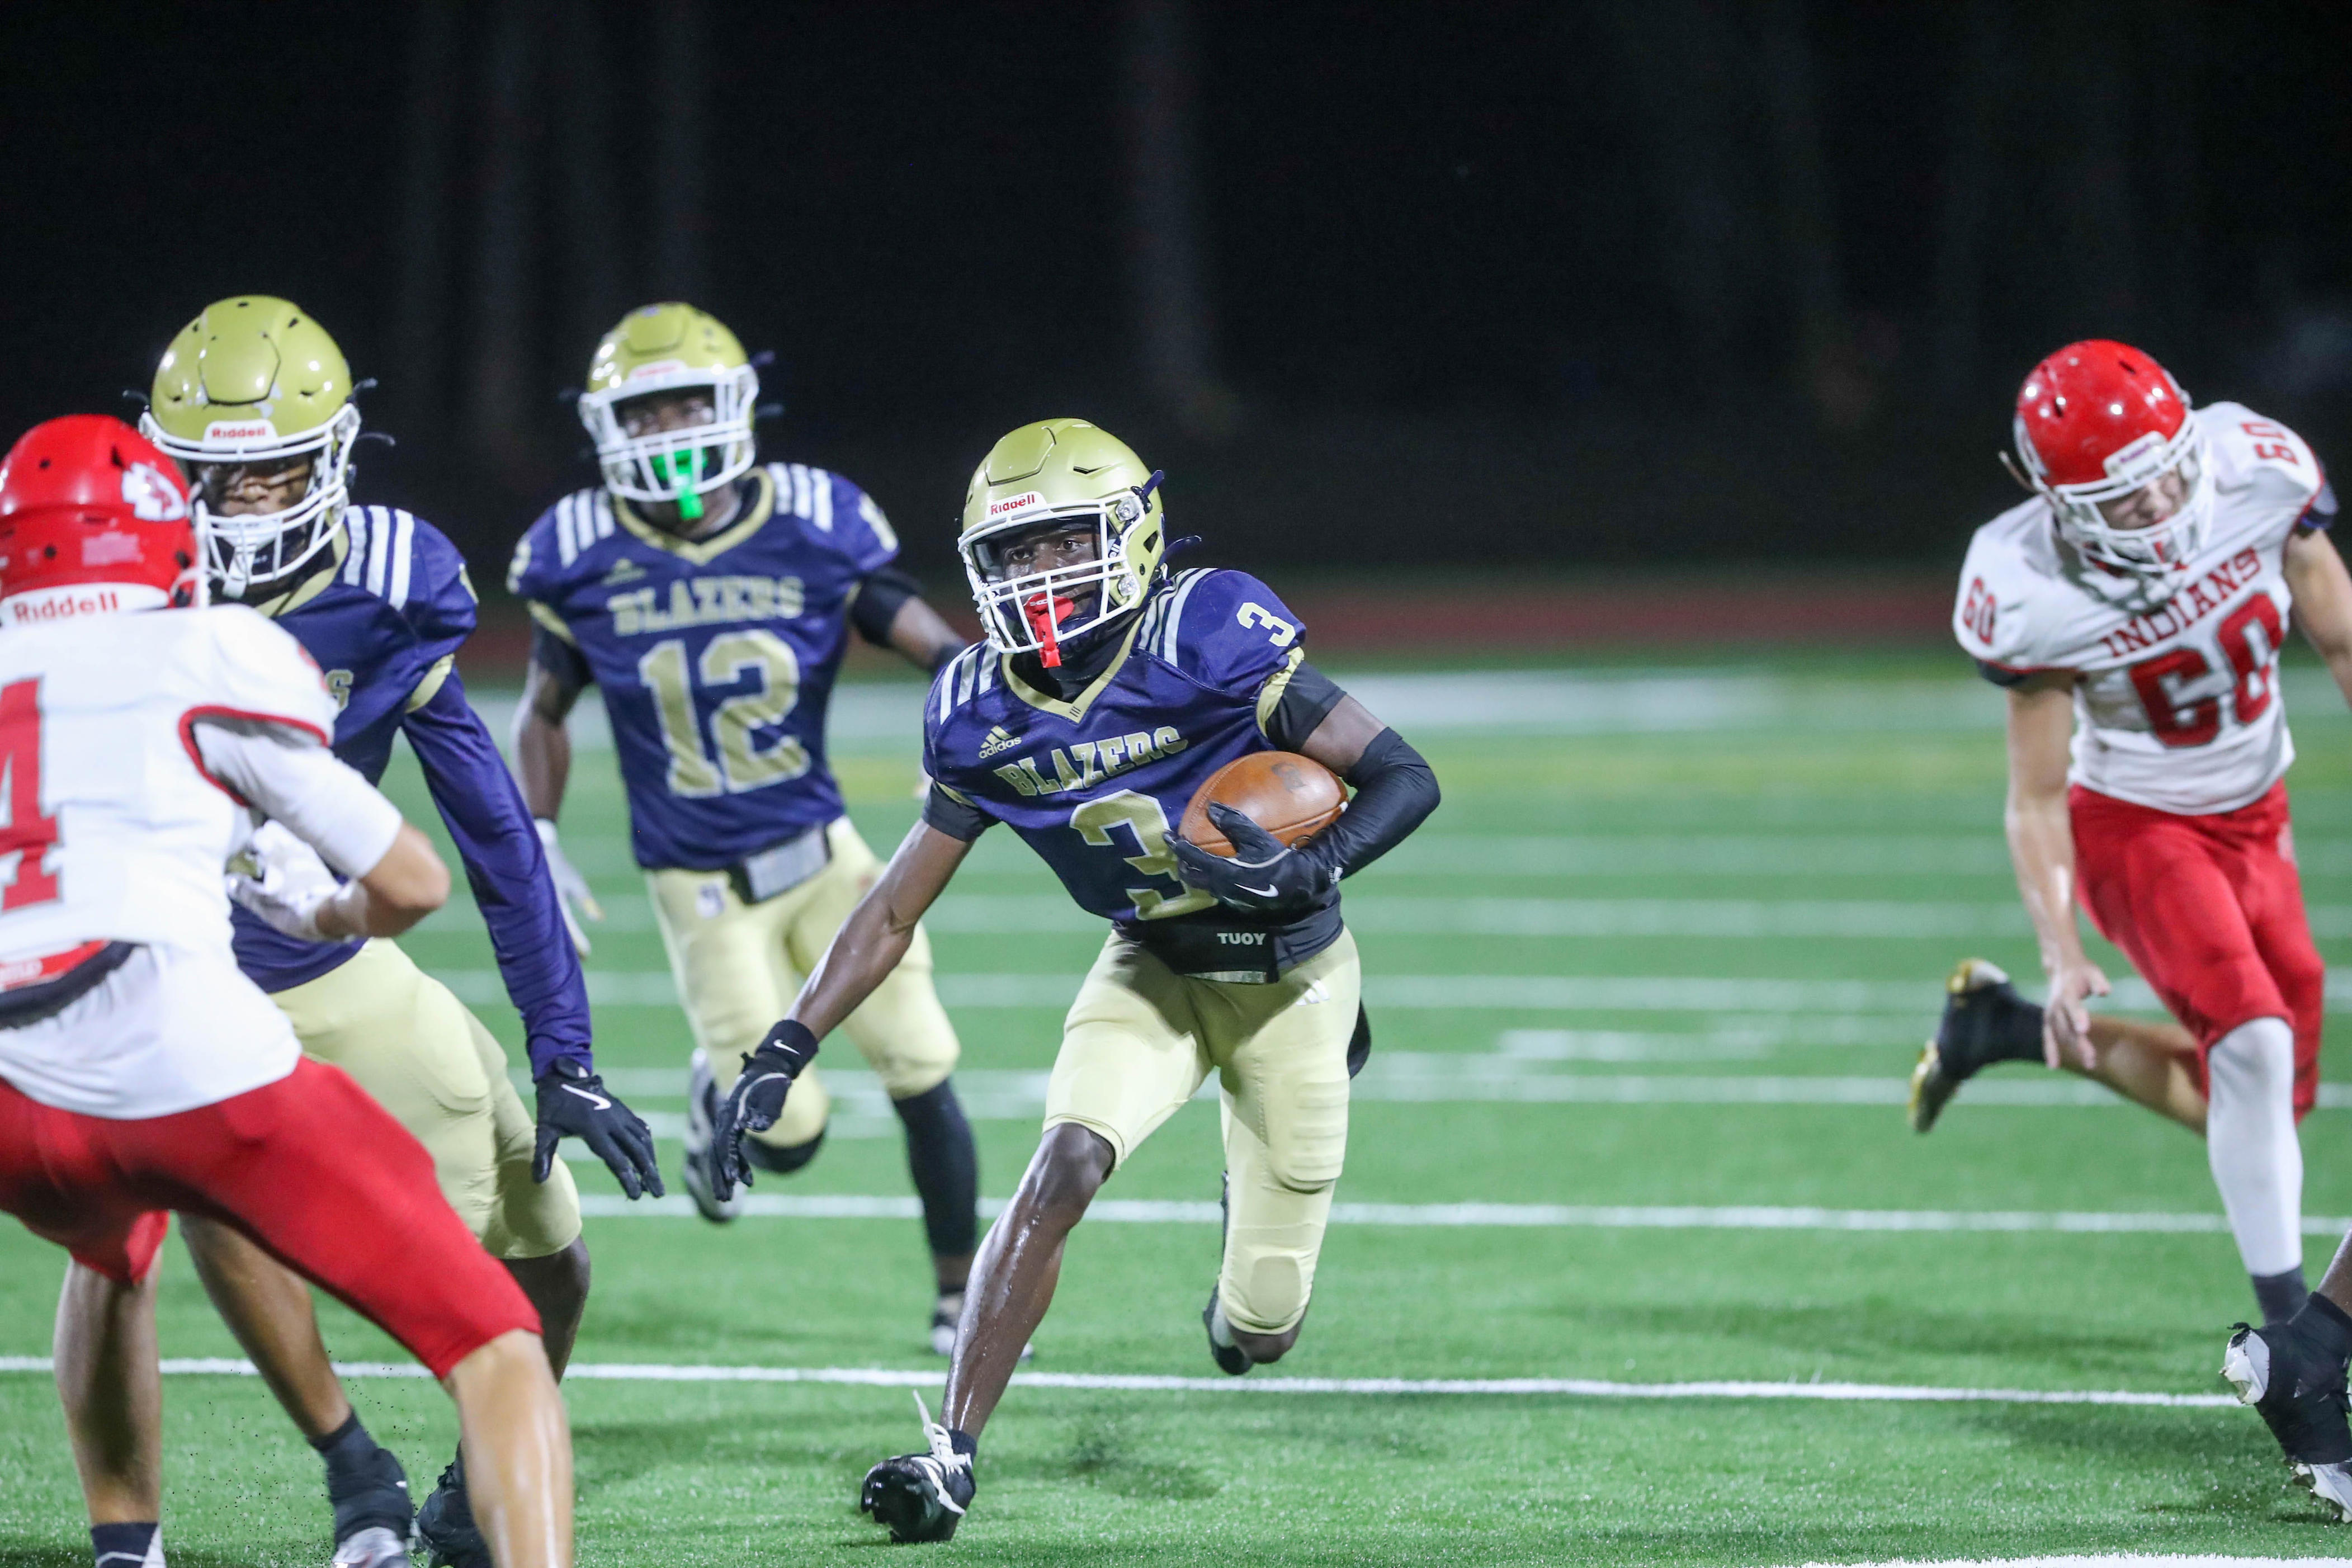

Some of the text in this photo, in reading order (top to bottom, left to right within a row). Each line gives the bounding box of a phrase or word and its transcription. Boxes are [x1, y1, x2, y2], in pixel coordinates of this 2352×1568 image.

[212, 427, 266, 438] Riddell
[990, 494, 1035, 515] Riddell
[13, 592, 119, 622] Riddell
[606, 575, 804, 637] BLAZERS
[1236, 602, 1296, 647] 3
[1963, 577, 1996, 645] 60
[2100, 546, 2261, 658] INDIANS
[2129, 592, 2285, 747] 60
[638, 629, 811, 798] 12
[979, 735, 1022, 759] adidas
[993, 725, 1189, 796] BLAZERS
[1069, 788, 1219, 921] 3
[1216, 932, 1267, 946] TUOY
